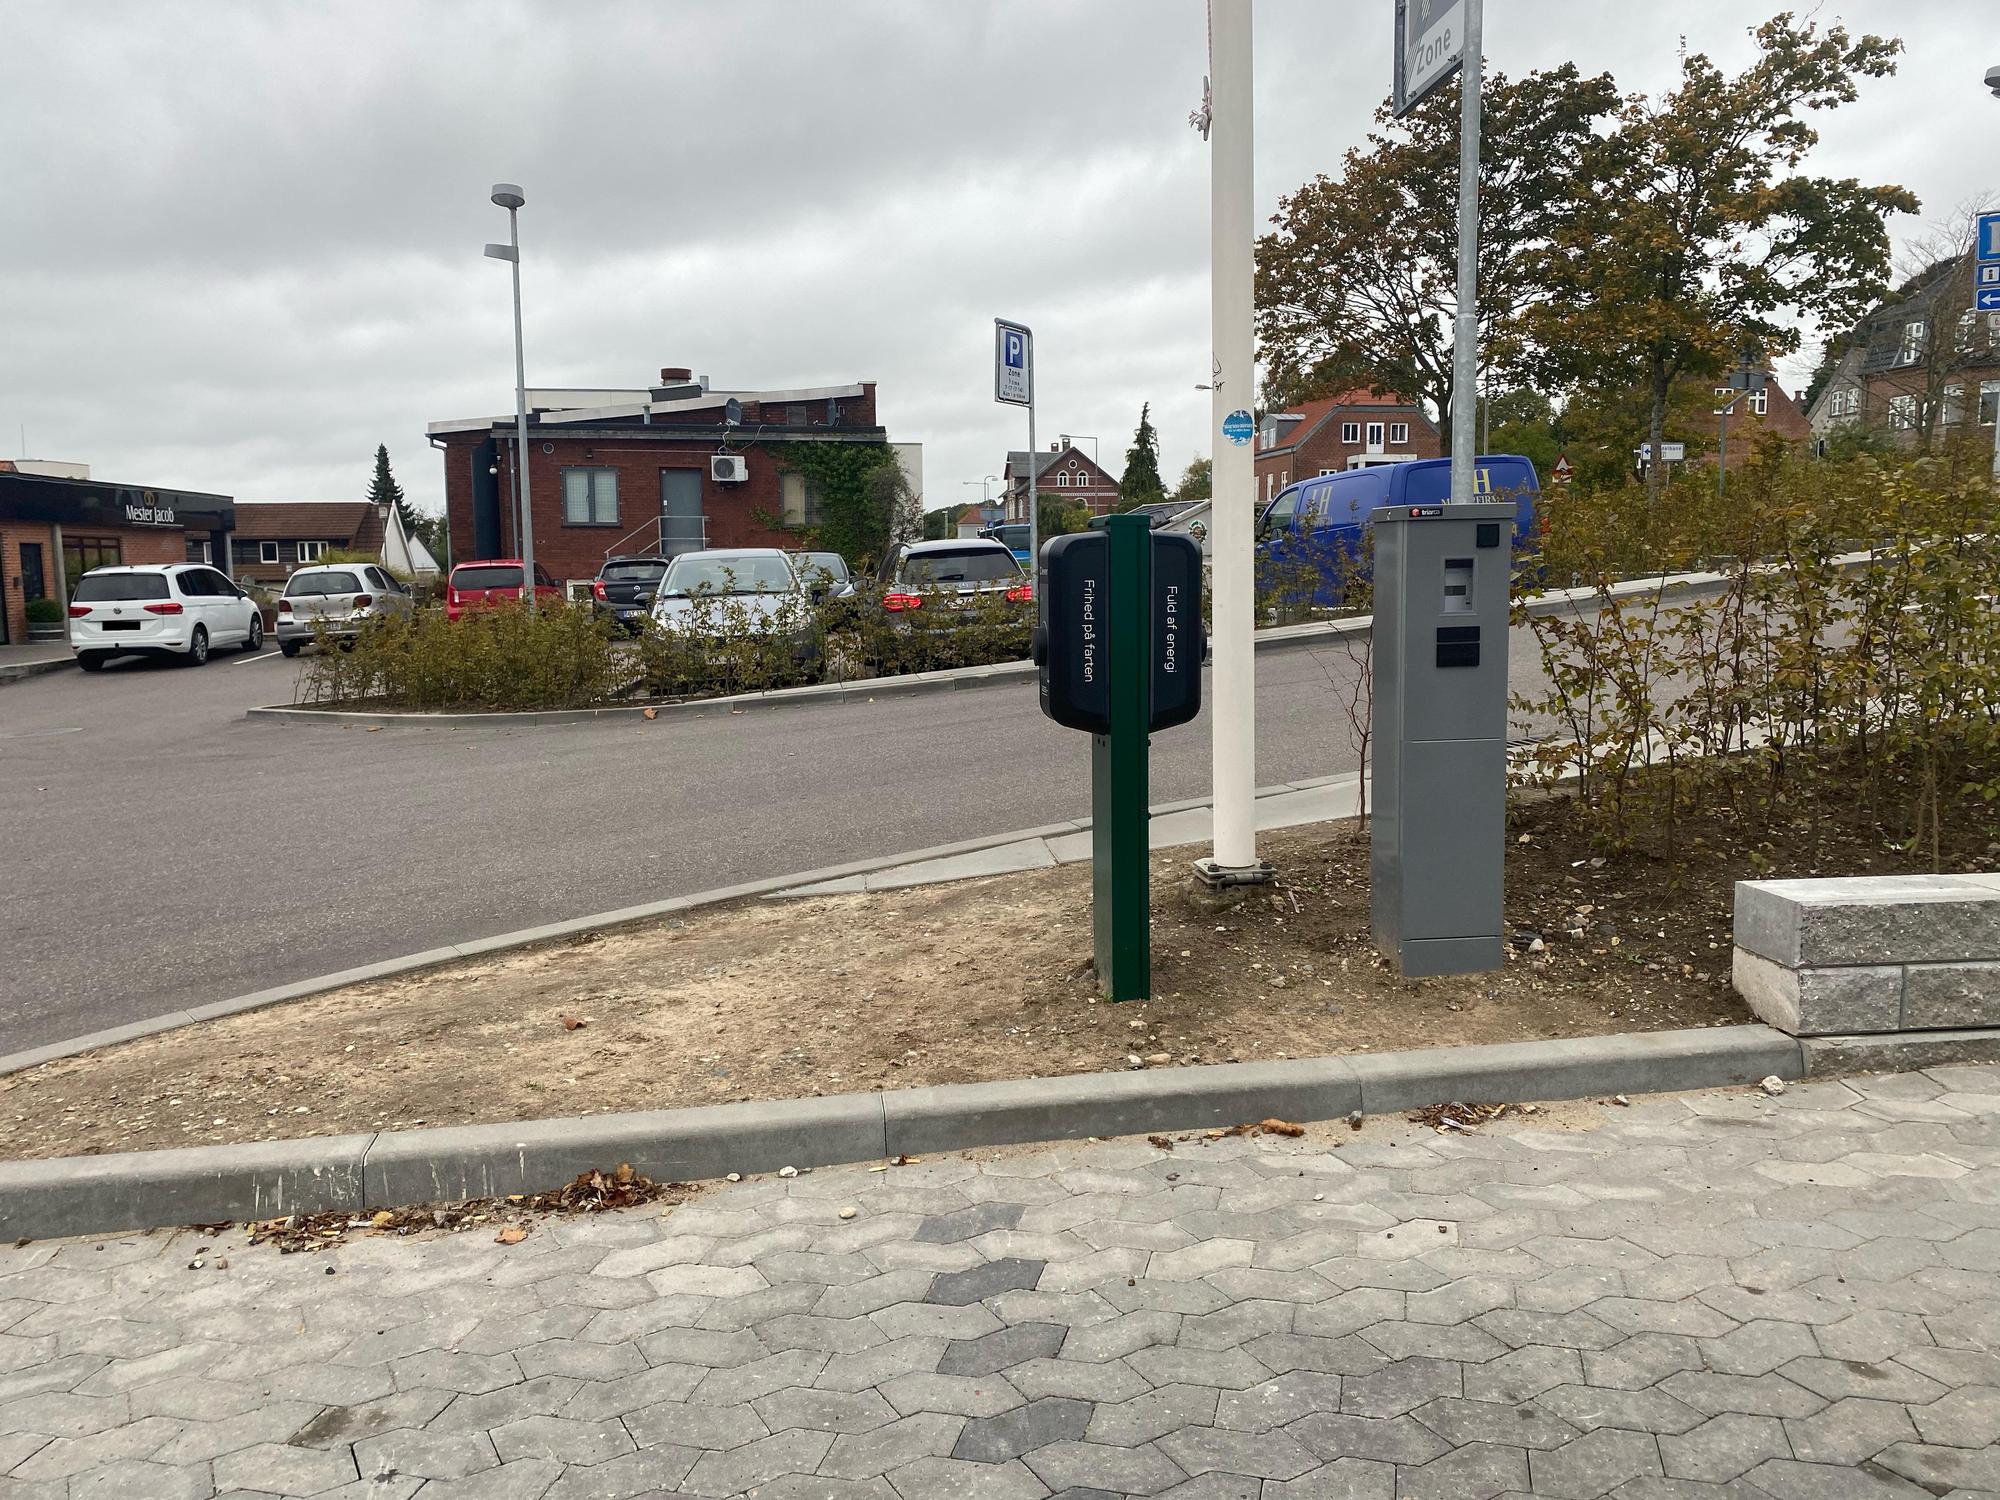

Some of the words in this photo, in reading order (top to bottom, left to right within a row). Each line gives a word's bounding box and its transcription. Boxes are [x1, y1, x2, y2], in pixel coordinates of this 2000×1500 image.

[1417, 28, 1451, 75] Zone
[1009, 335, 1020, 363] P
[1008, 368, 1021, 378] Zone
[125, 504, 152, 521] Mester
[153, 506, 175, 524] Jacob
[1084, 579, 1095, 620] Frihed
[1166, 586, 1178, 613] Fuld
[1081, 624, 1096, 640] på
[1166, 617, 1178, 630] af
[1084, 644, 1095, 682] farten
[1163, 634, 1178, 673] energi
